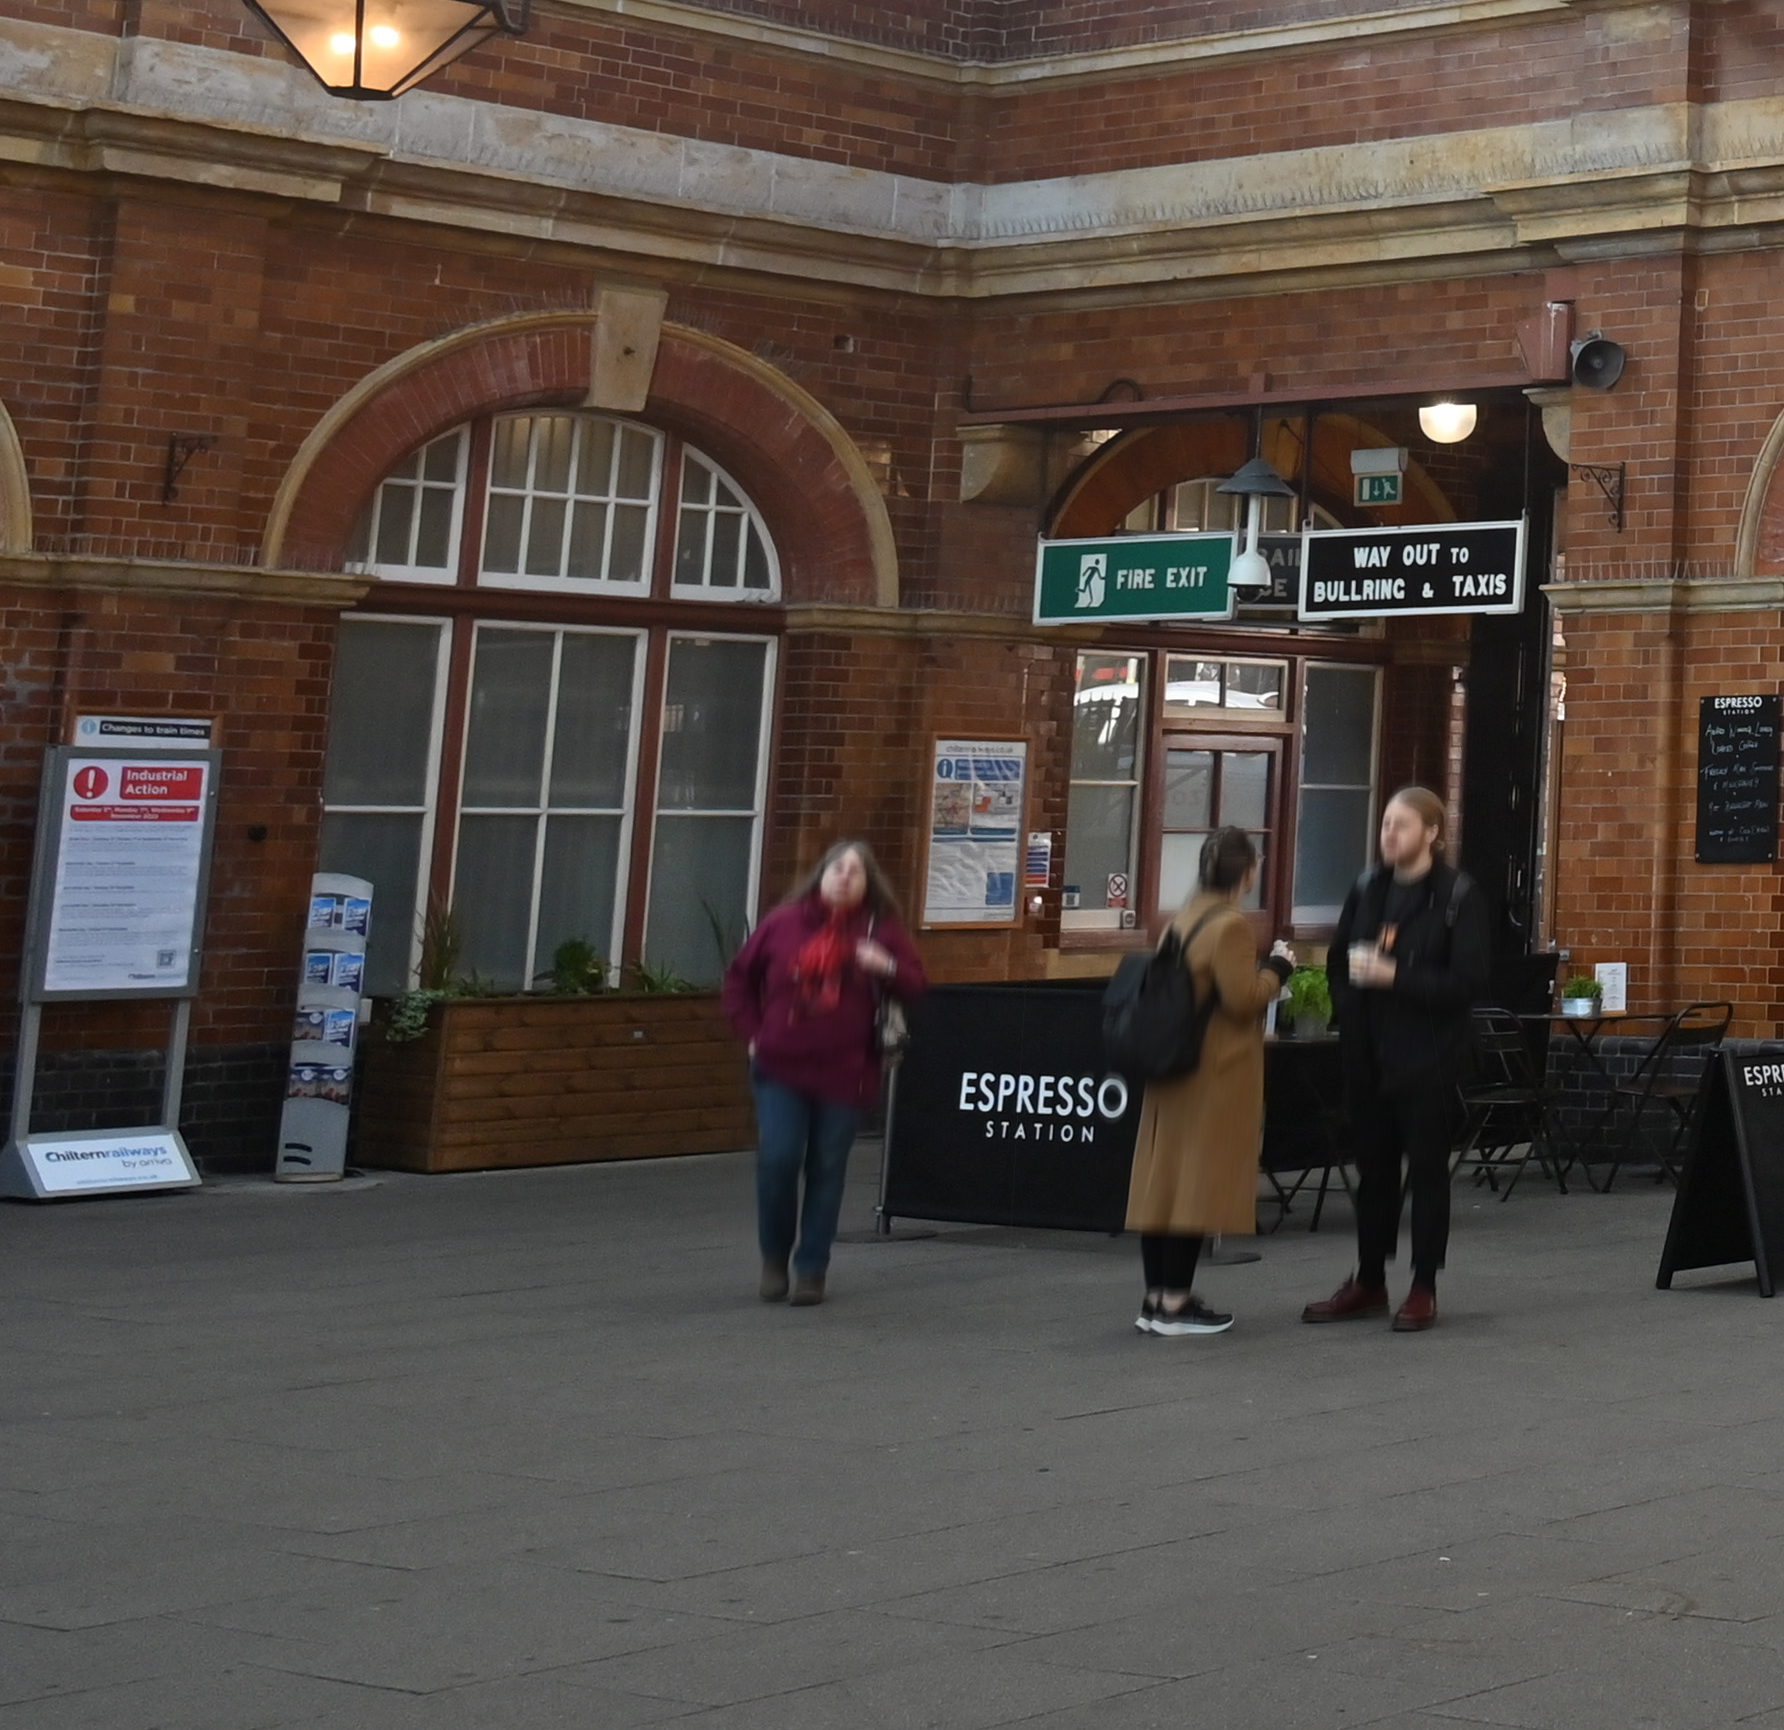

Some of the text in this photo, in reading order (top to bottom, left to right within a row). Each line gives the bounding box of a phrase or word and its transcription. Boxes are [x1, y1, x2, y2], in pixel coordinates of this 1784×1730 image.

[1353, 544, 1470, 569] WAY OUT TO
[1116, 566, 1208, 590] FIRE EXIT
[1313, 578, 1406, 603] BULLRING
[1422, 582, 1435, 599] &
[1452, 573, 1508, 598] TAXIS
[1714, 696, 1762, 709] ESPRESSO
[102, 723, 206, 736] Changes train times
[127, 770, 188, 781] Industrial
[125, 784, 168, 795] Action
[959, 1072, 1128, 1118] ESPRESSO
[985, 1121, 1096, 1143] STATION
[46, 1146, 168, 1163] Chilternrailways
[122, 1159, 136, 1168] by
